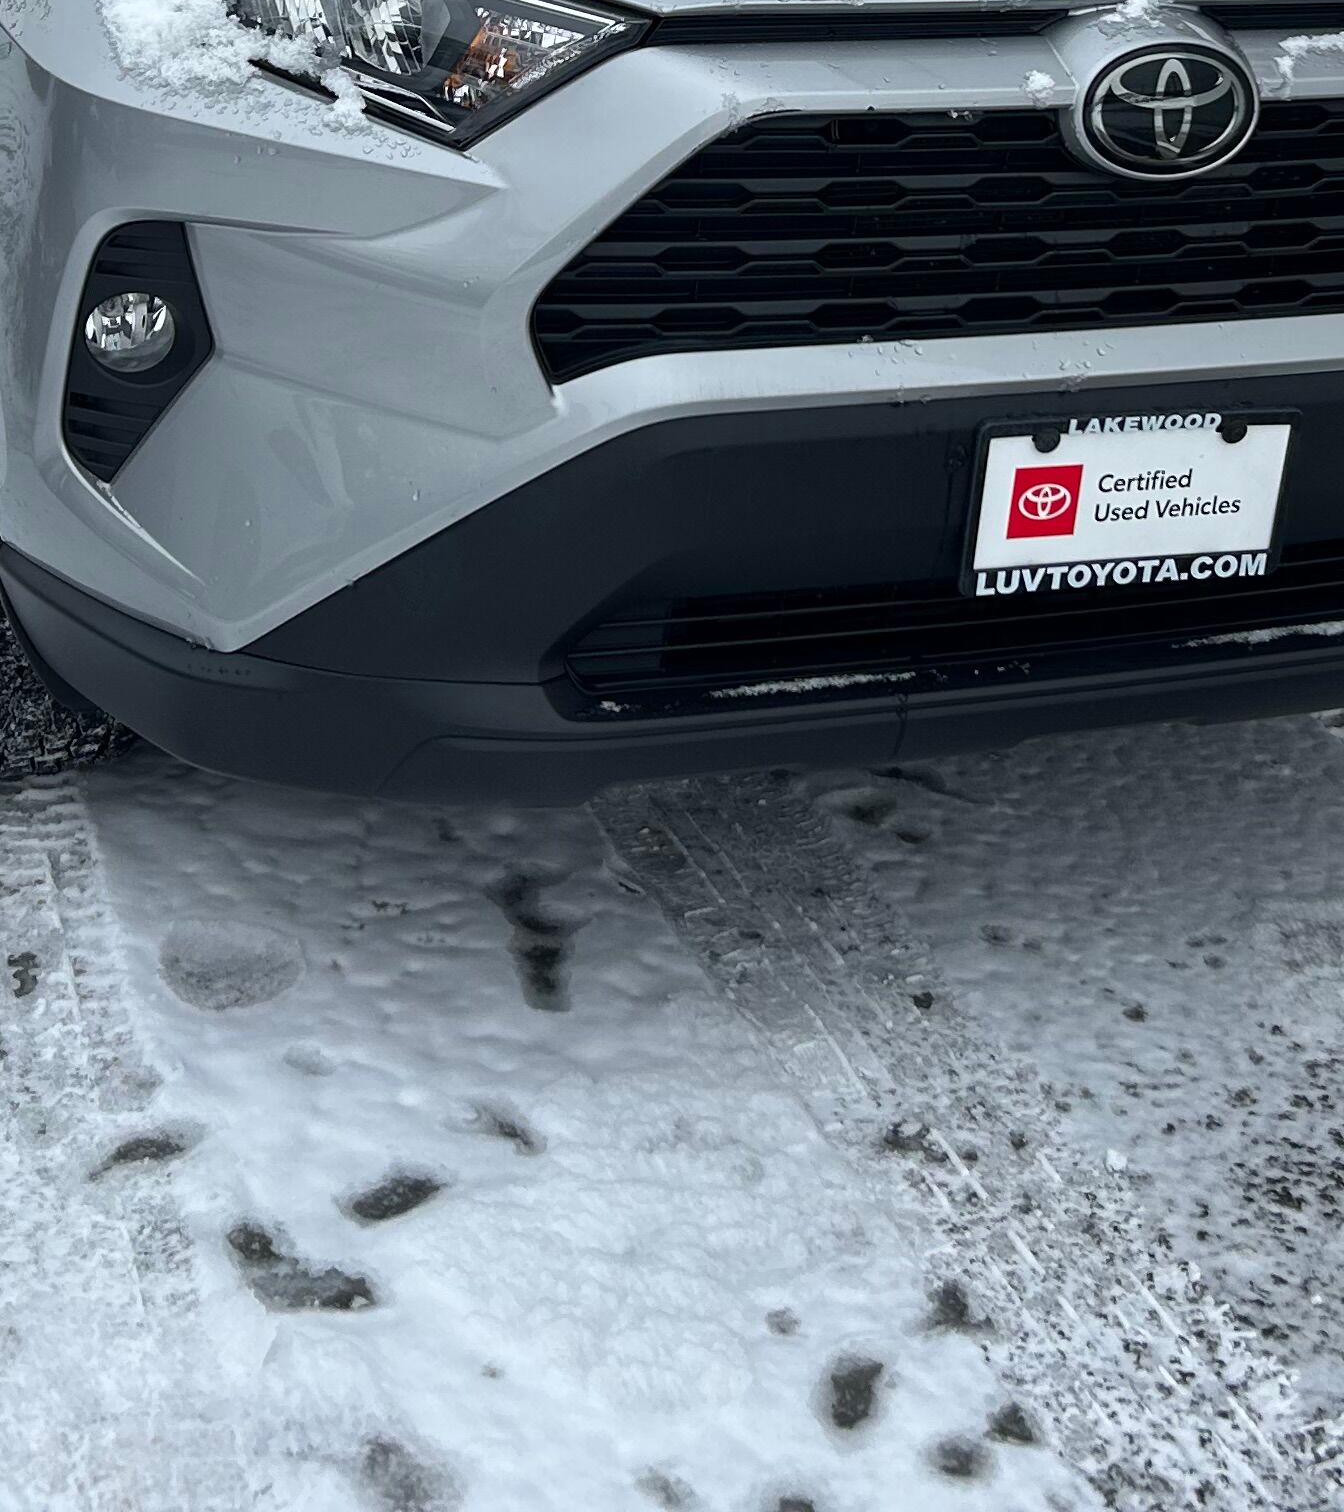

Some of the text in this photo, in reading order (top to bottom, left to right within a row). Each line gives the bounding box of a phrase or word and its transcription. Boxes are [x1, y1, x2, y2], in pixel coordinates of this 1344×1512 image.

[1067, 412, 1223, 436] LAKEWOOD
[1098, 468, 1194, 494] Certified
[1093, 495, 1242, 523] Used Vehicles
[975, 552, 1269, 597] LUVTOYOTA.COM
